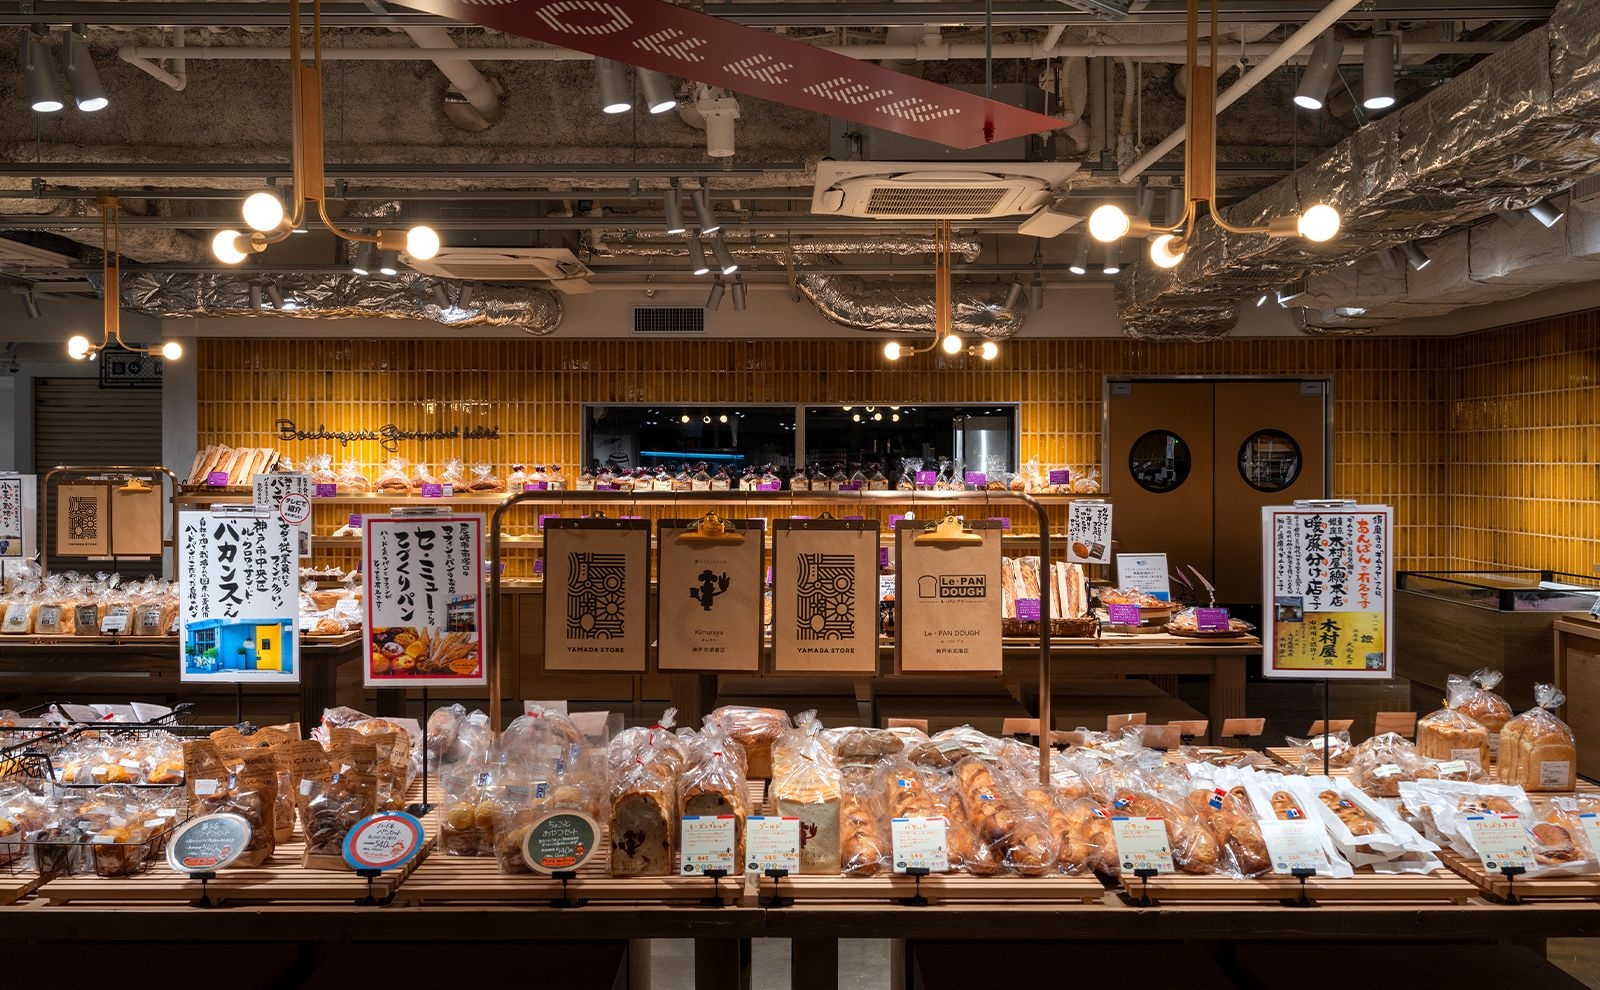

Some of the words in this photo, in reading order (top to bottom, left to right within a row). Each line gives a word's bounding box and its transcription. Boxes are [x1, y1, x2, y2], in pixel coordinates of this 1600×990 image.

[463, 0, 963, 122] OFFEE
[275, 418, 379, 447] Boulangerie
[380, 424, 458, 452] Gourmand
[286, 497, 307, 508] テレビで
[287, 504, 302, 514] 紹介
[252, 518, 270, 592] 神戸市中央区
[1357, 518, 1372, 609] あんぱんで有名です
[393, 530, 415, 622] こづくりパン
[941, 587, 984, 596] DOUGH
[694, 629, 724, 637] Kimuraya
[1319, 618, 1341, 658] 木村屋
[759, 821, 783, 830] ゴールド
